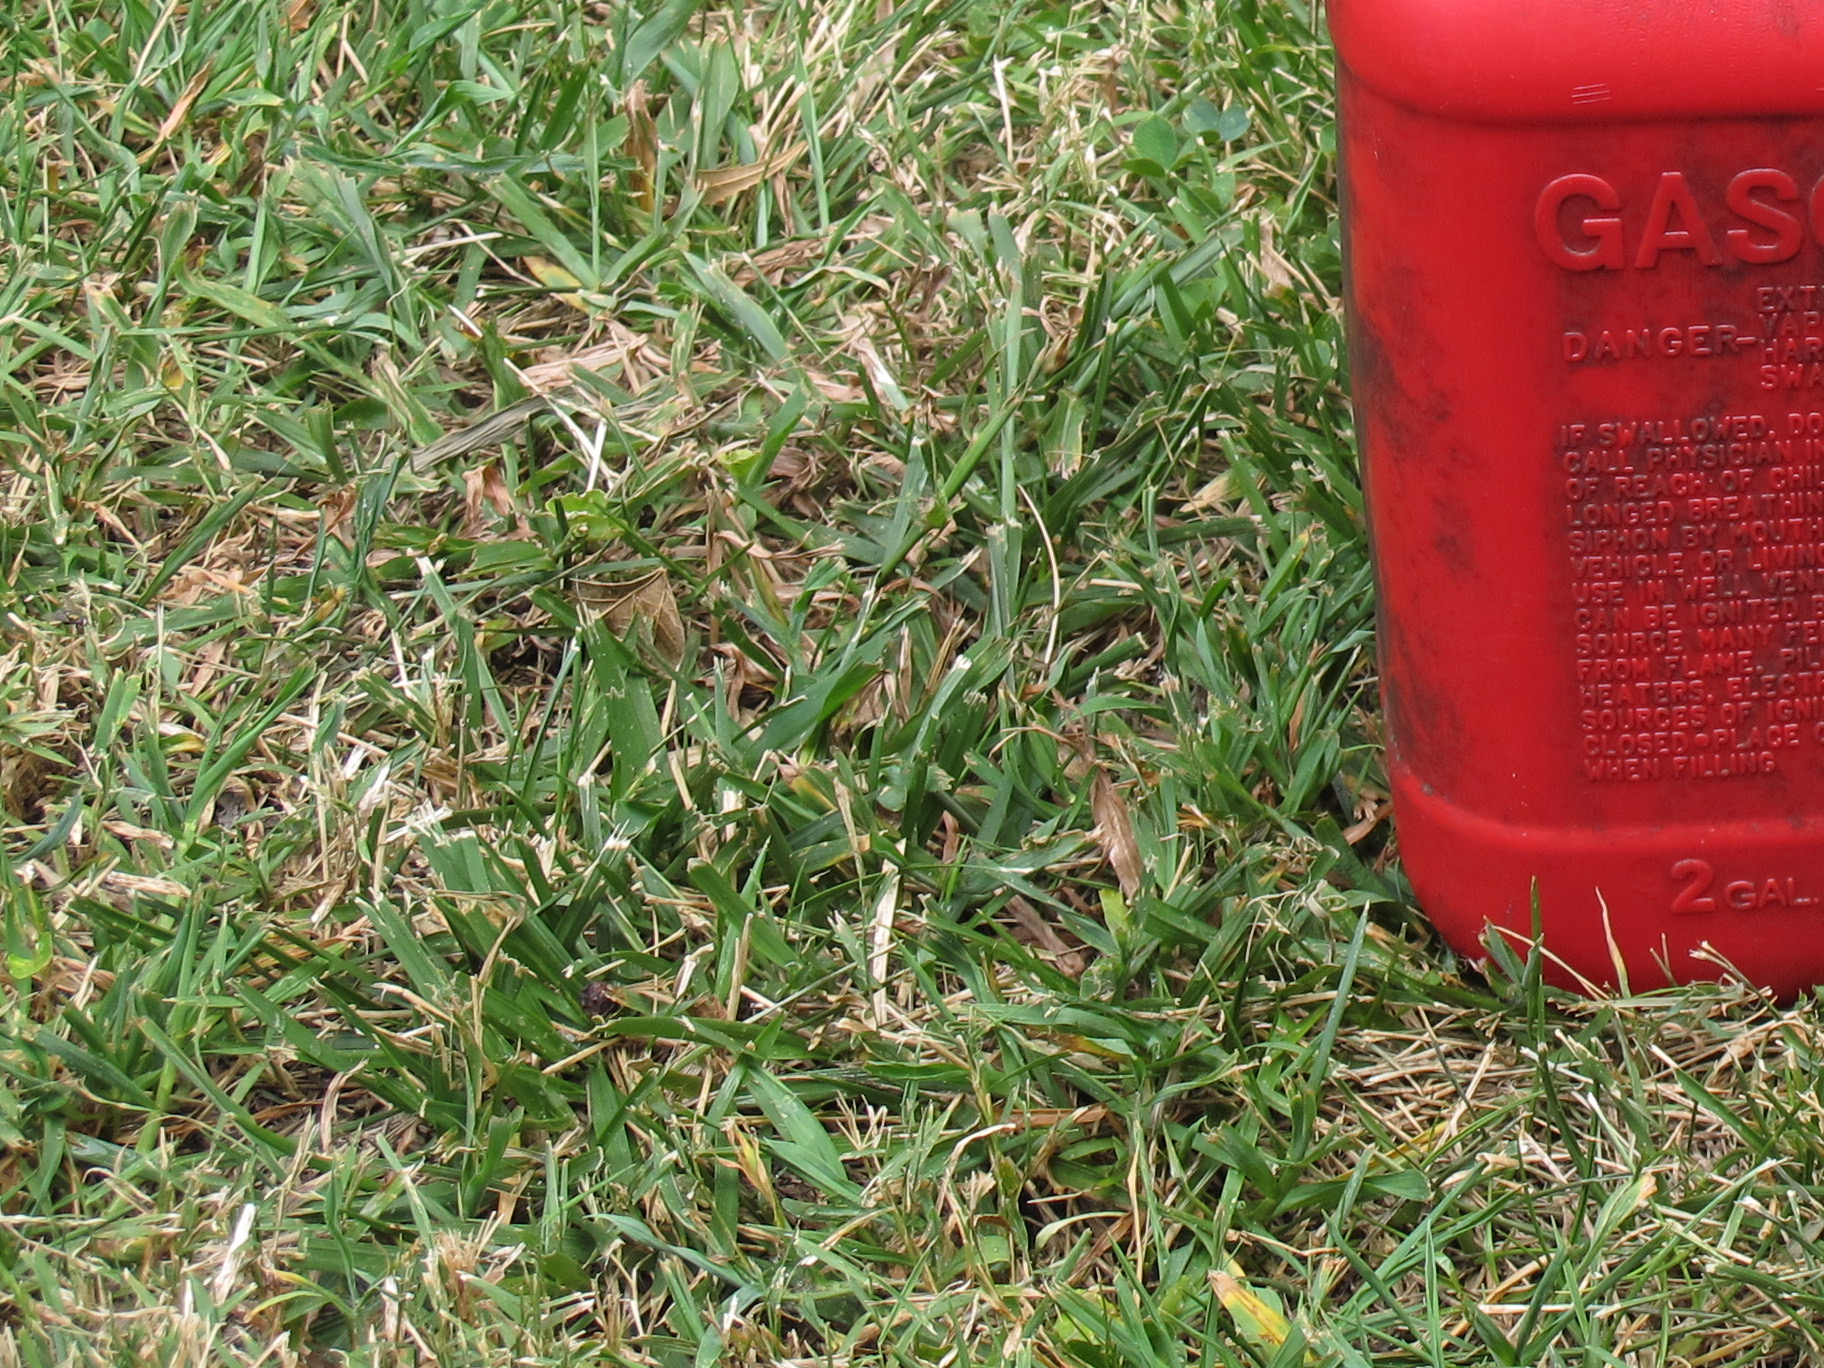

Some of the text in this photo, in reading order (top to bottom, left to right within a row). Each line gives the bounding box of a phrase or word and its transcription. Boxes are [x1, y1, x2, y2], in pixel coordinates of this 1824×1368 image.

[1561, 423, 1587, 447] IF
[1788, 412, 1824, 435] DO
[1563, 450, 1635, 474] CALL
[1648, 439, 1793, 470] PHYSICIAN
[1566, 477, 1600, 501] OF
[1721, 468, 1755, 493] OF
[1566, 501, 1674, 527] LONGED
[1568, 527, 1671, 553] SIPHON
[1680, 523, 1717, 549] BY
[1730, 517, 1823, 544] MOUTH
[1570, 551, 1685, 579] VEHICLE
[1700, 549, 1734, 572] OR
[1571, 581, 1625, 605] USE
[1637, 579, 1666, 602] IN
[1678, 574, 1751, 599] WELL
[1574, 606, 1630, 631] CAN
[1643, 603, 1678, 628] BE
[1689, 597, 1799, 625] IGNITED
[1575, 629, 1684, 656] SOURCE
[1696, 624, 1774, 650] MANY
[1577, 656, 1650, 681] FROM
[1581, 704, 1708, 732] SOURCES
[1720, 701, 1753, 725] OF
[1583, 731, 1689, 757] CLOSED
[1712, 723, 1801, 750] PLACE
[1584, 751, 1777, 782] WHEN FILLING
[1669, 857, 1717, 915] 2
